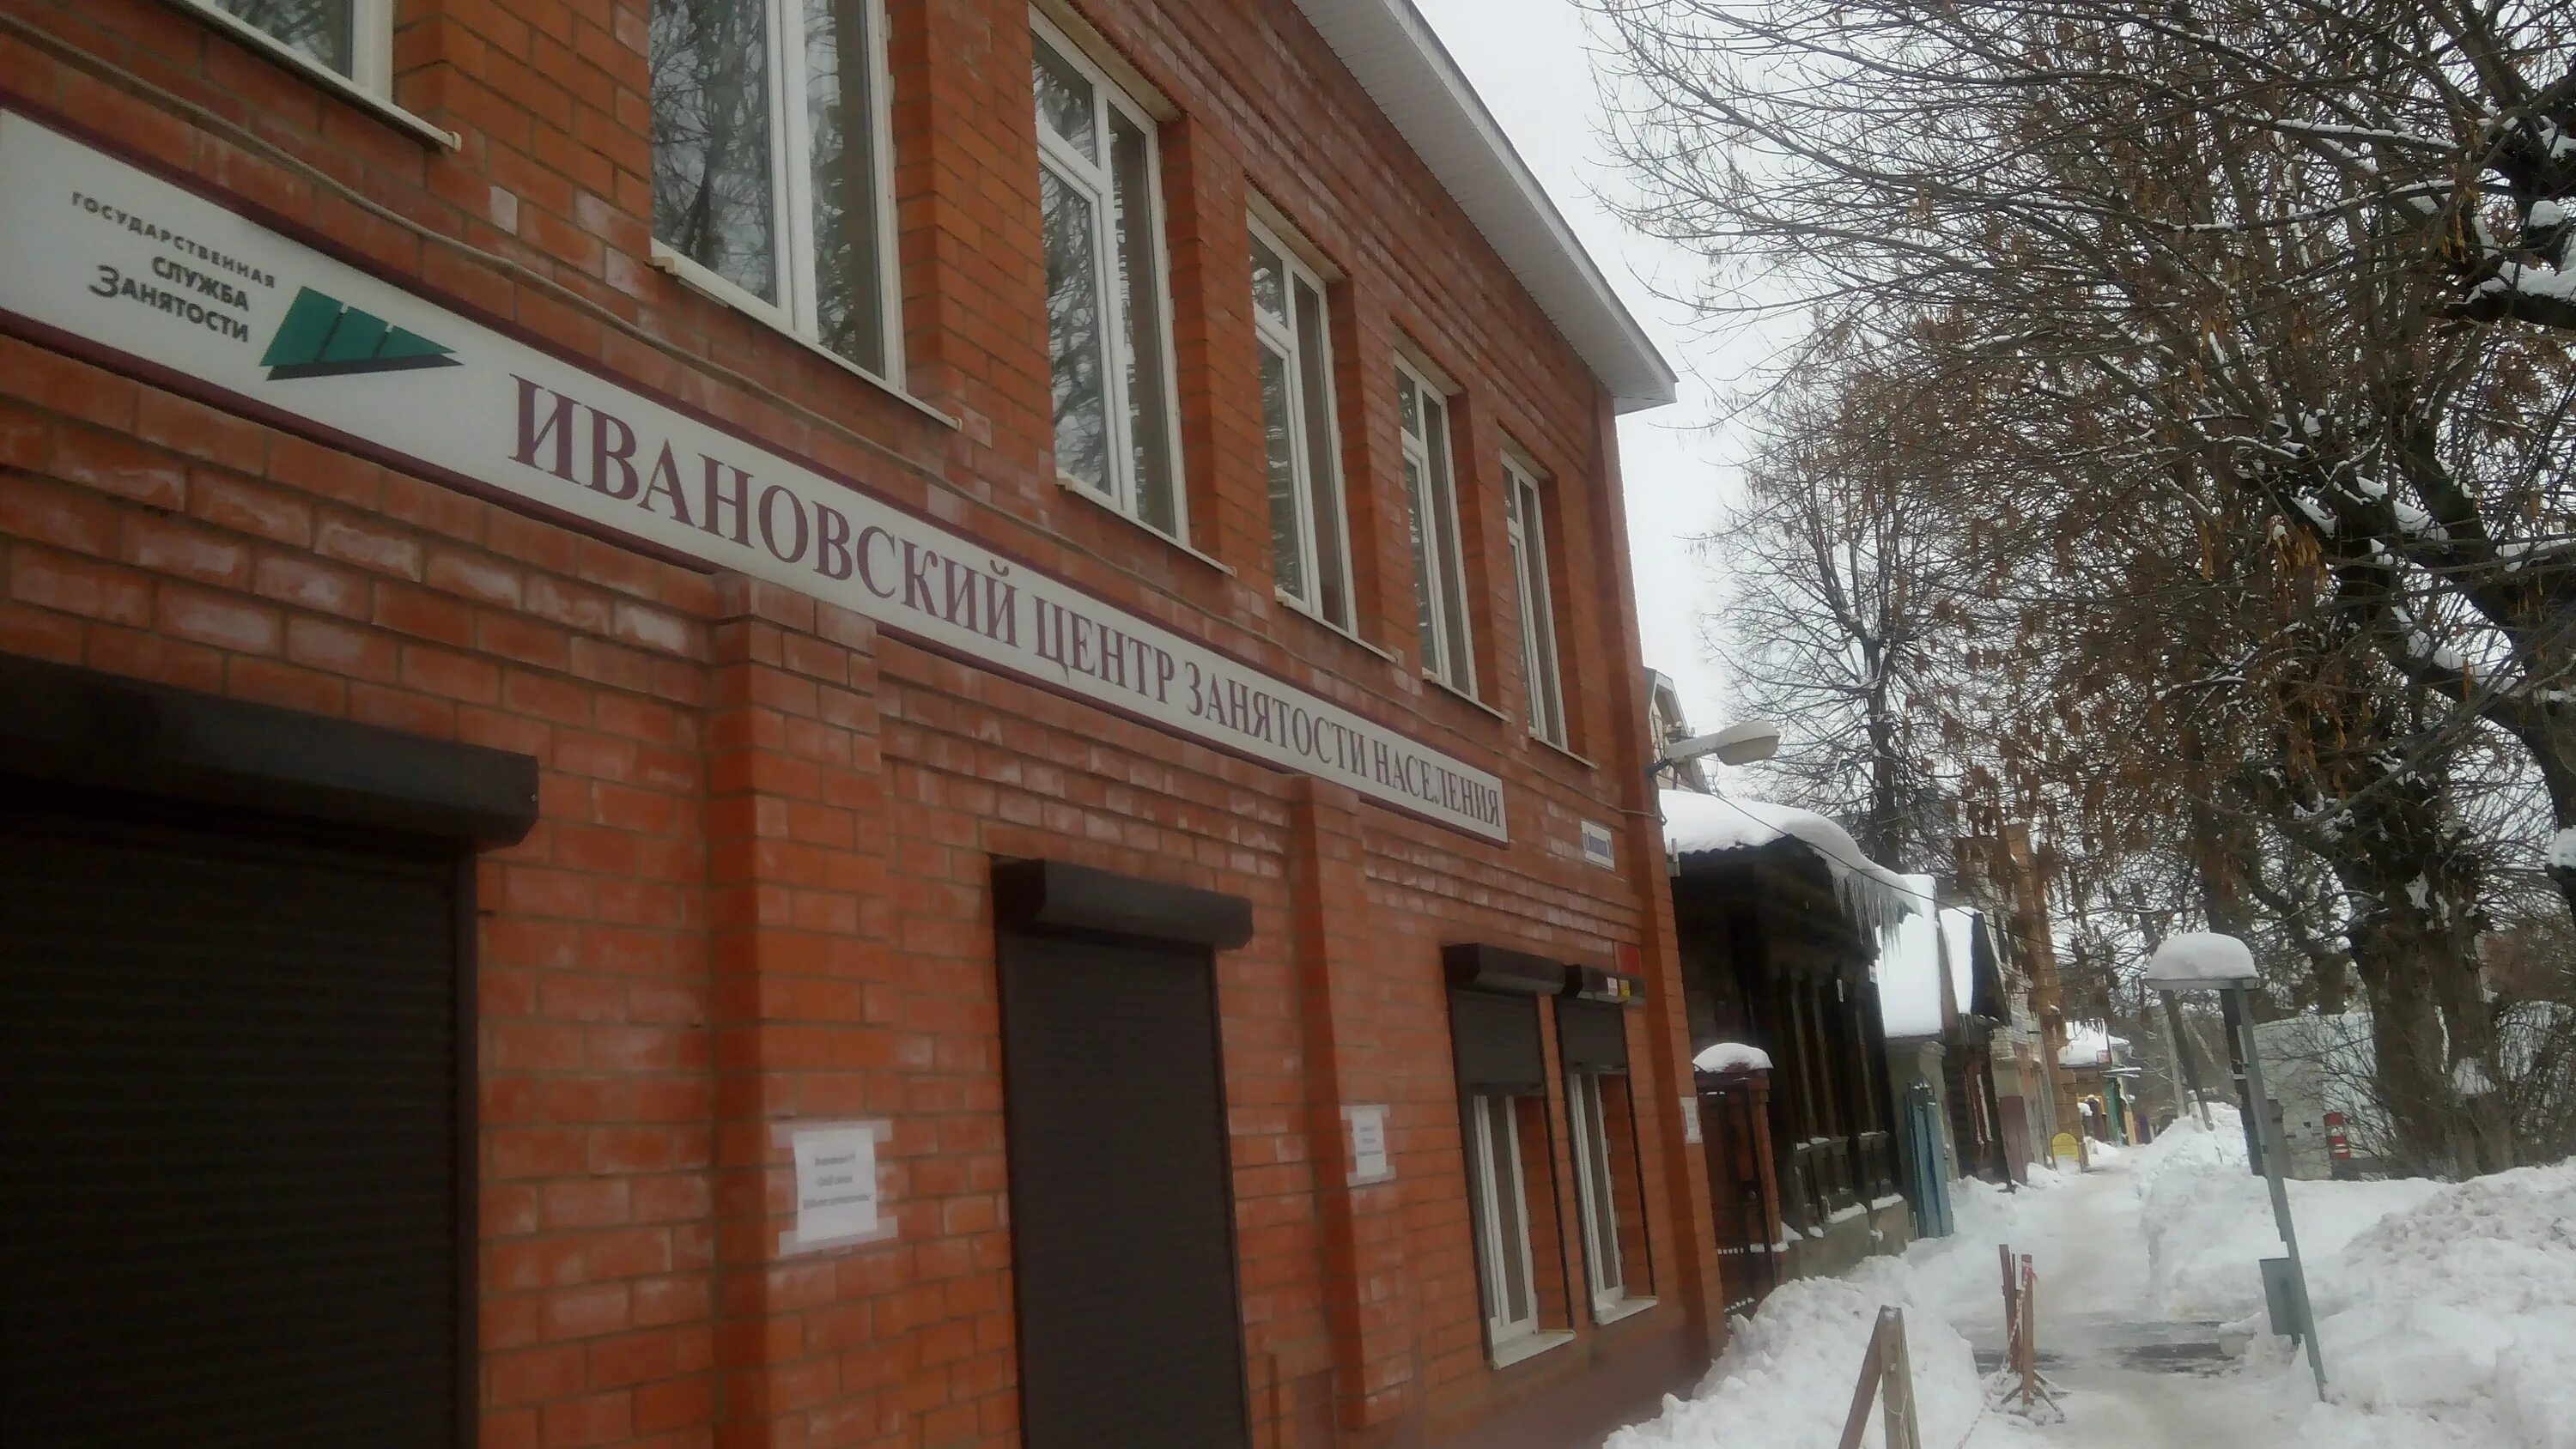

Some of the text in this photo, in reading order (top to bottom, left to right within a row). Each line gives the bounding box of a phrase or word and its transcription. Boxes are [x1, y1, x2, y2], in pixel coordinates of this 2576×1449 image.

[71, 191, 276, 288] ГОСУДАРСТВЕННАЯ
[151, 255, 250, 312] СЛУЖБА
[88, 264, 250, 343] ЗАНЯТОСТИ
[508, 373, 1502, 828] ИВАНОВСКИЙ ЦЕНТР ЗАНЯТОСТИ НАСЕЛЕНИЯ
